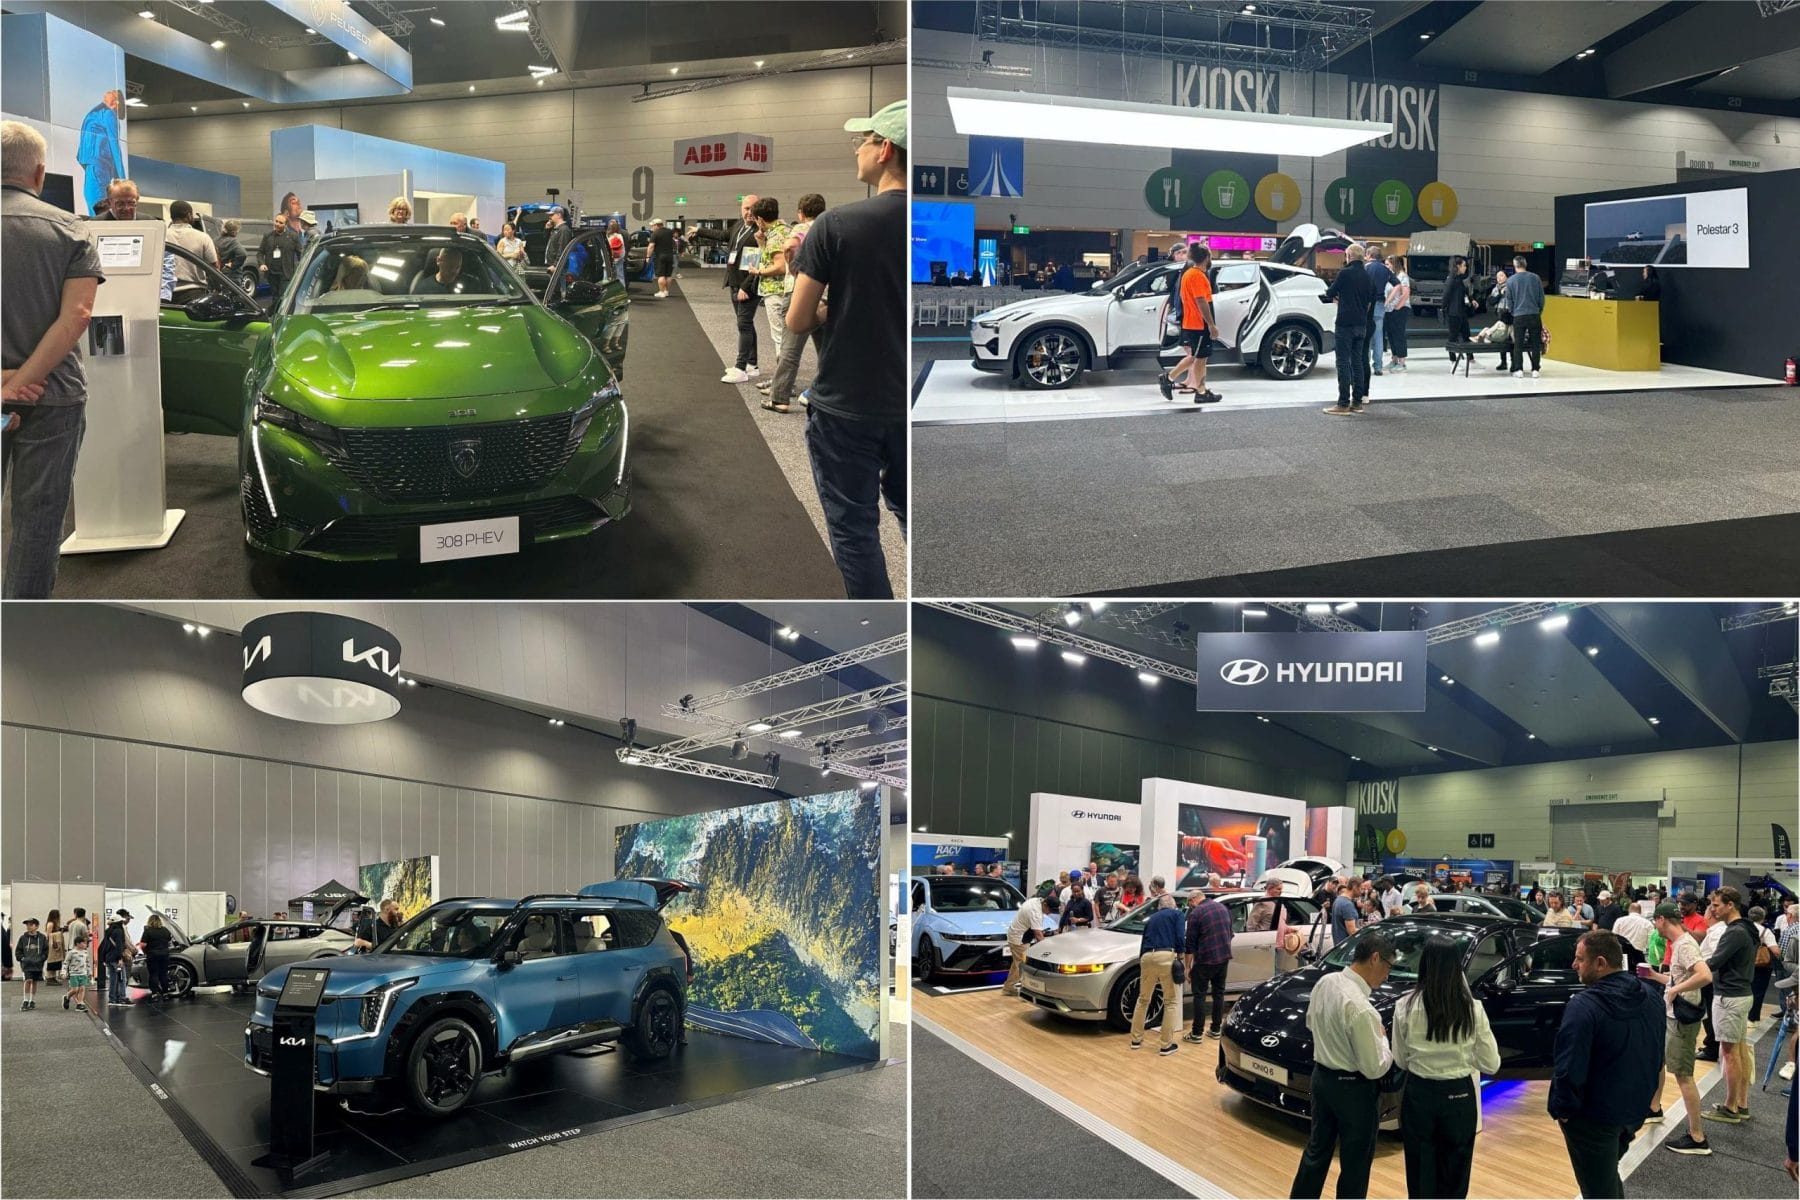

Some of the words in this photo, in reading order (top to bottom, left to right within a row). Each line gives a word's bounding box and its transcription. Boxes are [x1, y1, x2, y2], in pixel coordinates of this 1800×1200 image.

[330, 12, 371, 48] PEUGEOT
[1176, 63, 1279, 113] KIOSK
[1350, 81, 1436, 151] KIOSK
[684, 143, 727, 165] ABB
[743, 142, 768, 162] ABB
[632, 166, 654, 221] 9
[1697, 224, 1731, 235] Polestar
[1732, 223, 1739, 234] 3
[436, 534, 463, 548] 308
[465, 530, 504, 546] PHEV
[1277, 661, 1403, 683] HYUNDAI
[1360, 781, 1398, 815] KIOSK
[1087, 812, 1122, 822] HYUNDAI
[935, 846, 962, 855] RACV
[1252, 1062, 1270, 1075] IONIQ
[1269, 1068, 1274, 1076] 6
[508, 1138, 540, 1149] WATCH
[538, 1132, 562, 1142] YOUR
[561, 1128, 581, 1137] STEP
